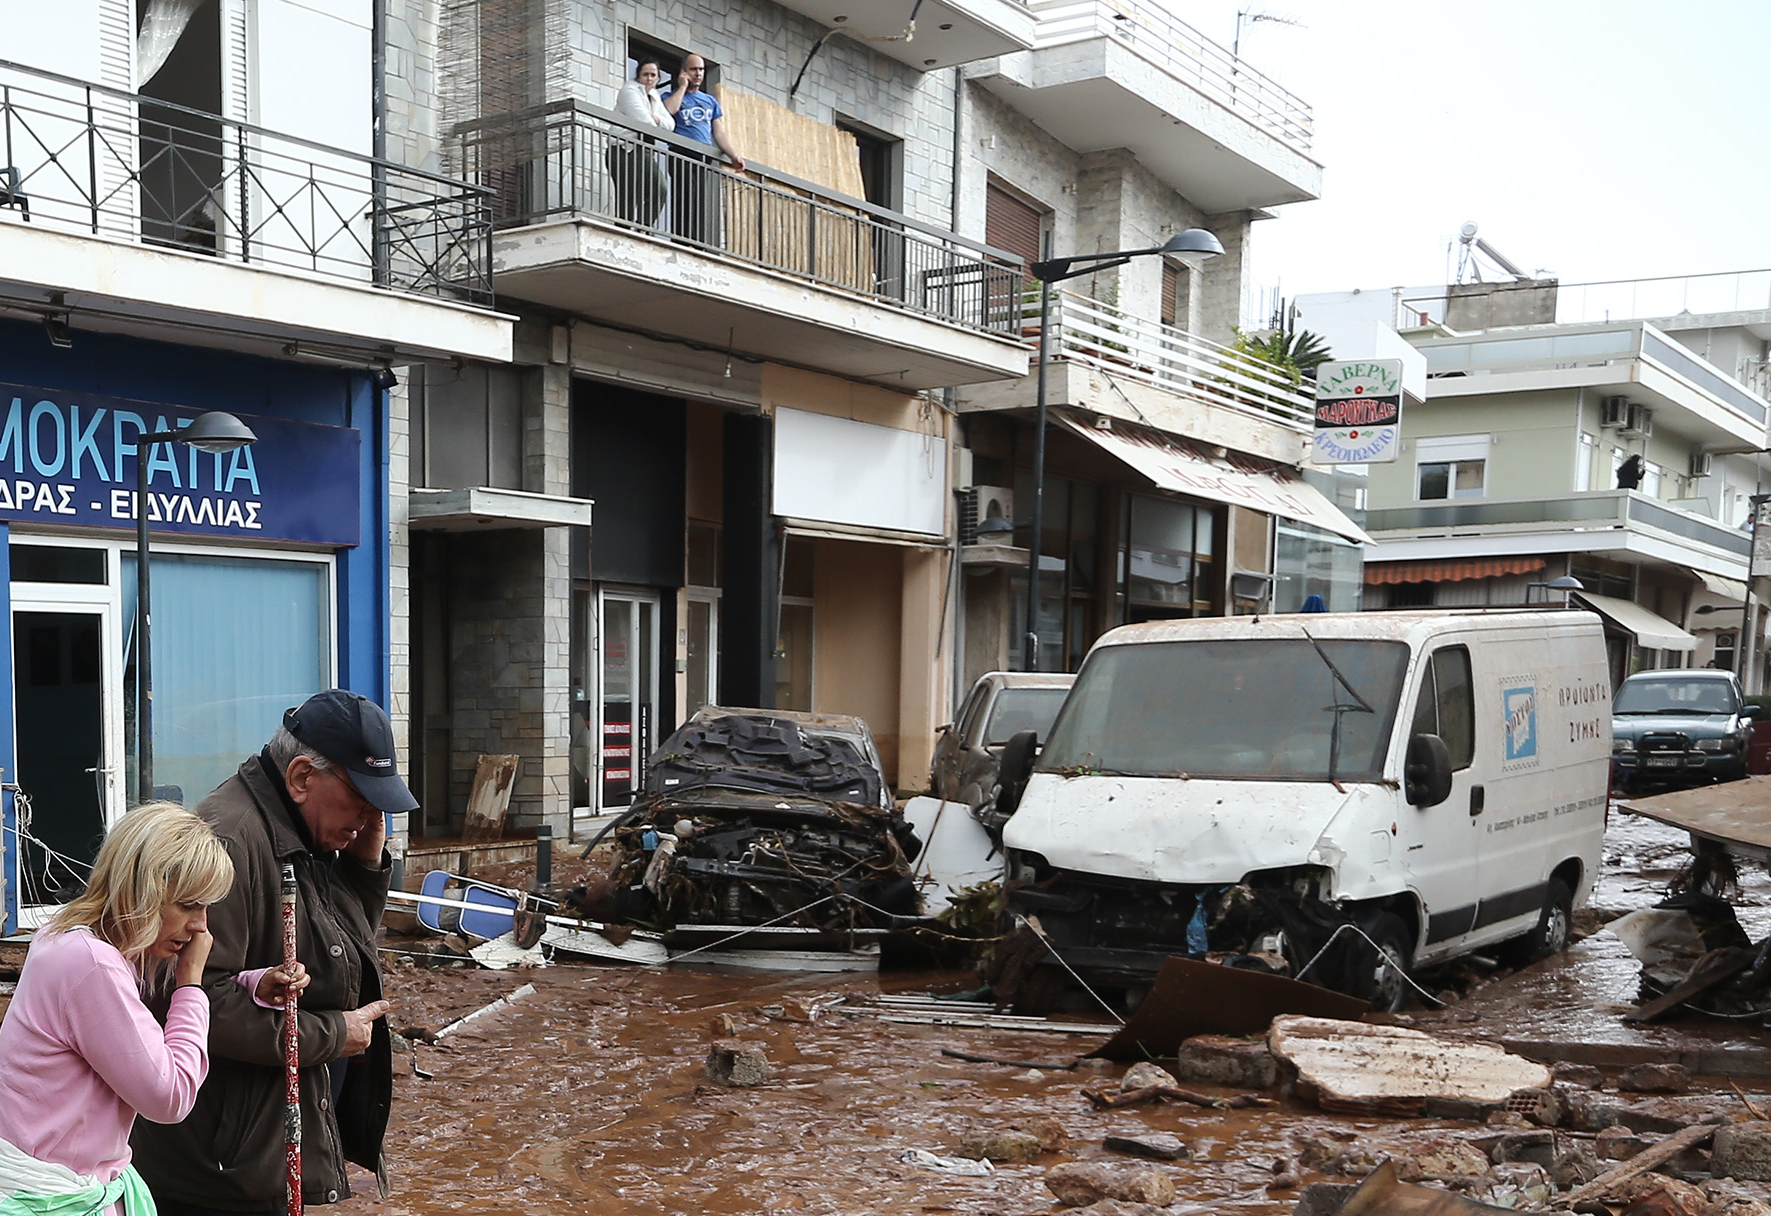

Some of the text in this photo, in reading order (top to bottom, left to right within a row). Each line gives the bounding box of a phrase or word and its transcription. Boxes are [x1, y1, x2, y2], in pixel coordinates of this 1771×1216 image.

[1319, 363, 1397, 393] ΤΑΒΕΡΝΑ
[1314, 428, 1395, 461] ΚΡΕΟΠΩΛΕΙΟ
[110, 489, 262, 530] ΕΙΔΥΛΛΙΑΣ
